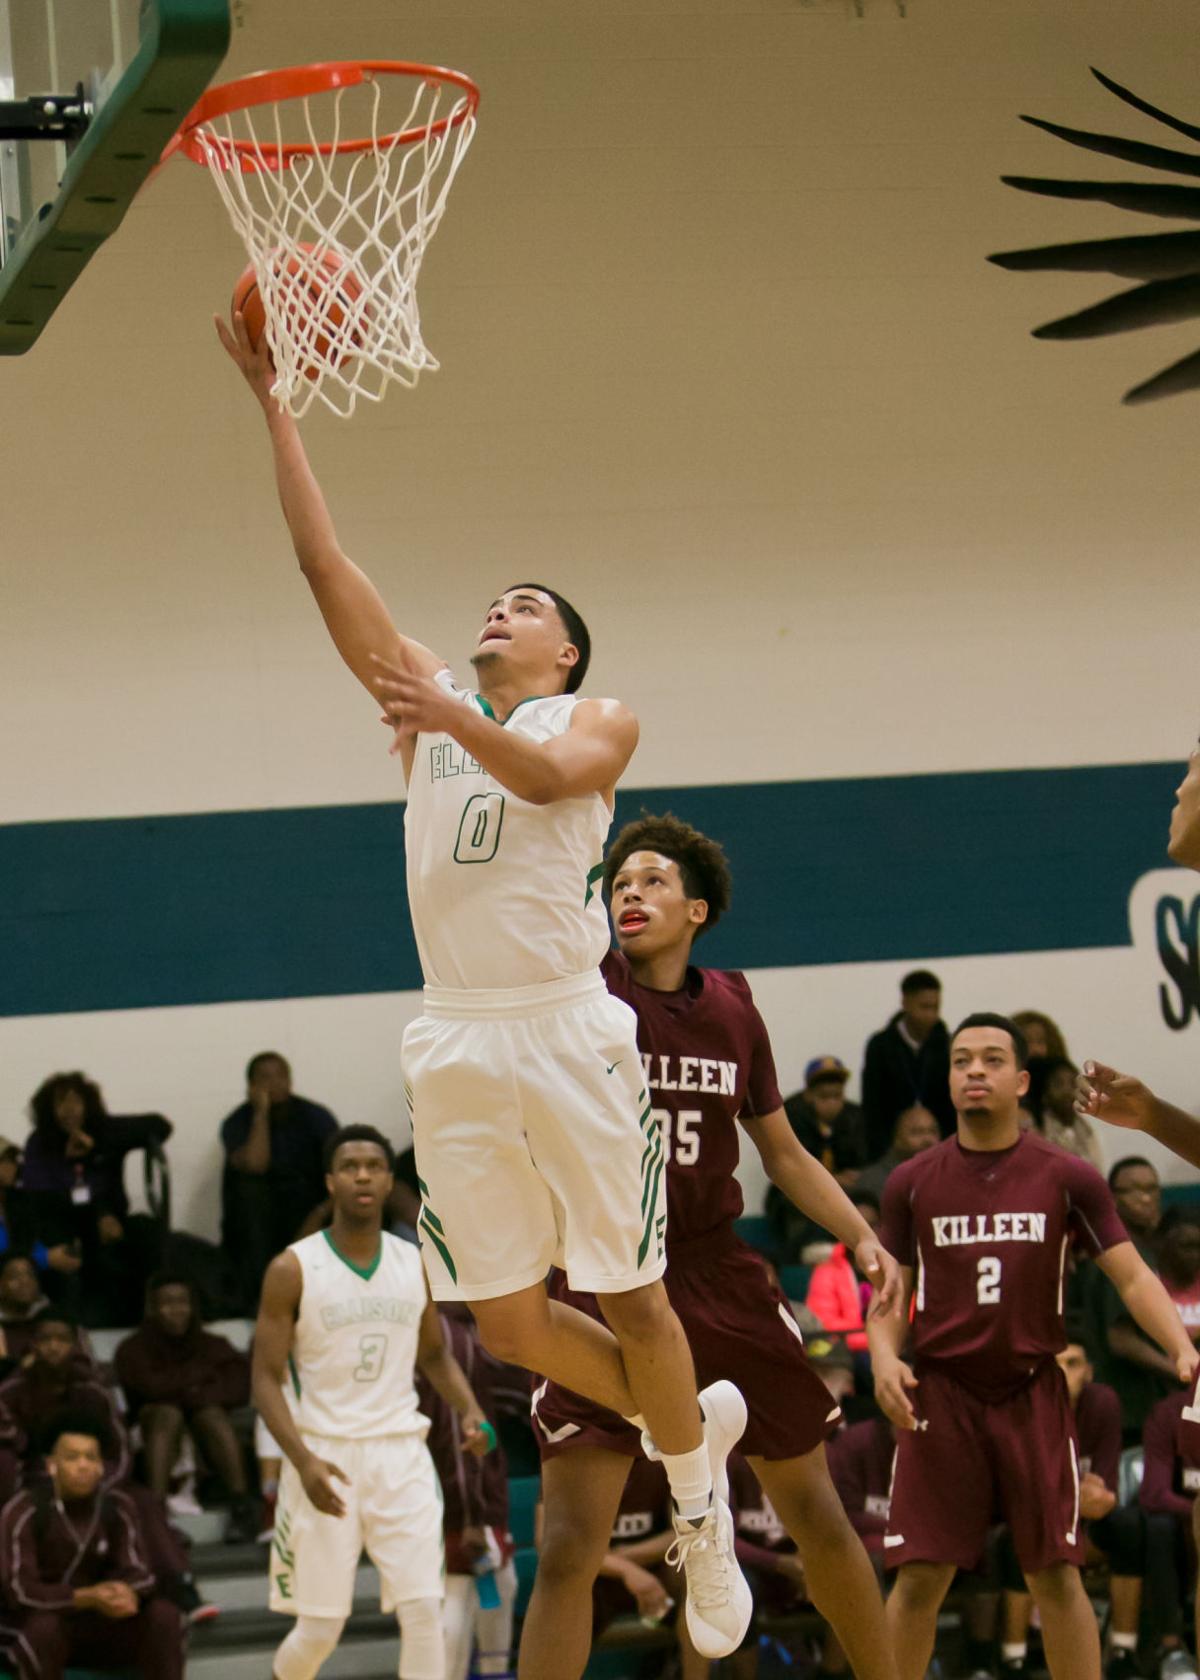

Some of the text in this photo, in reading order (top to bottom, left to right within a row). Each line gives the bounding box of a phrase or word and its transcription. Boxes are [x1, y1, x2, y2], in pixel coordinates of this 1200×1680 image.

[453, 792, 505, 864] 0
[641, 1052, 738, 1096] LLEEN
[931, 1212, 1047, 1248] KILLEEN
[976, 1256, 1002, 1305] 2
[353, 1332, 389, 1383] 3
